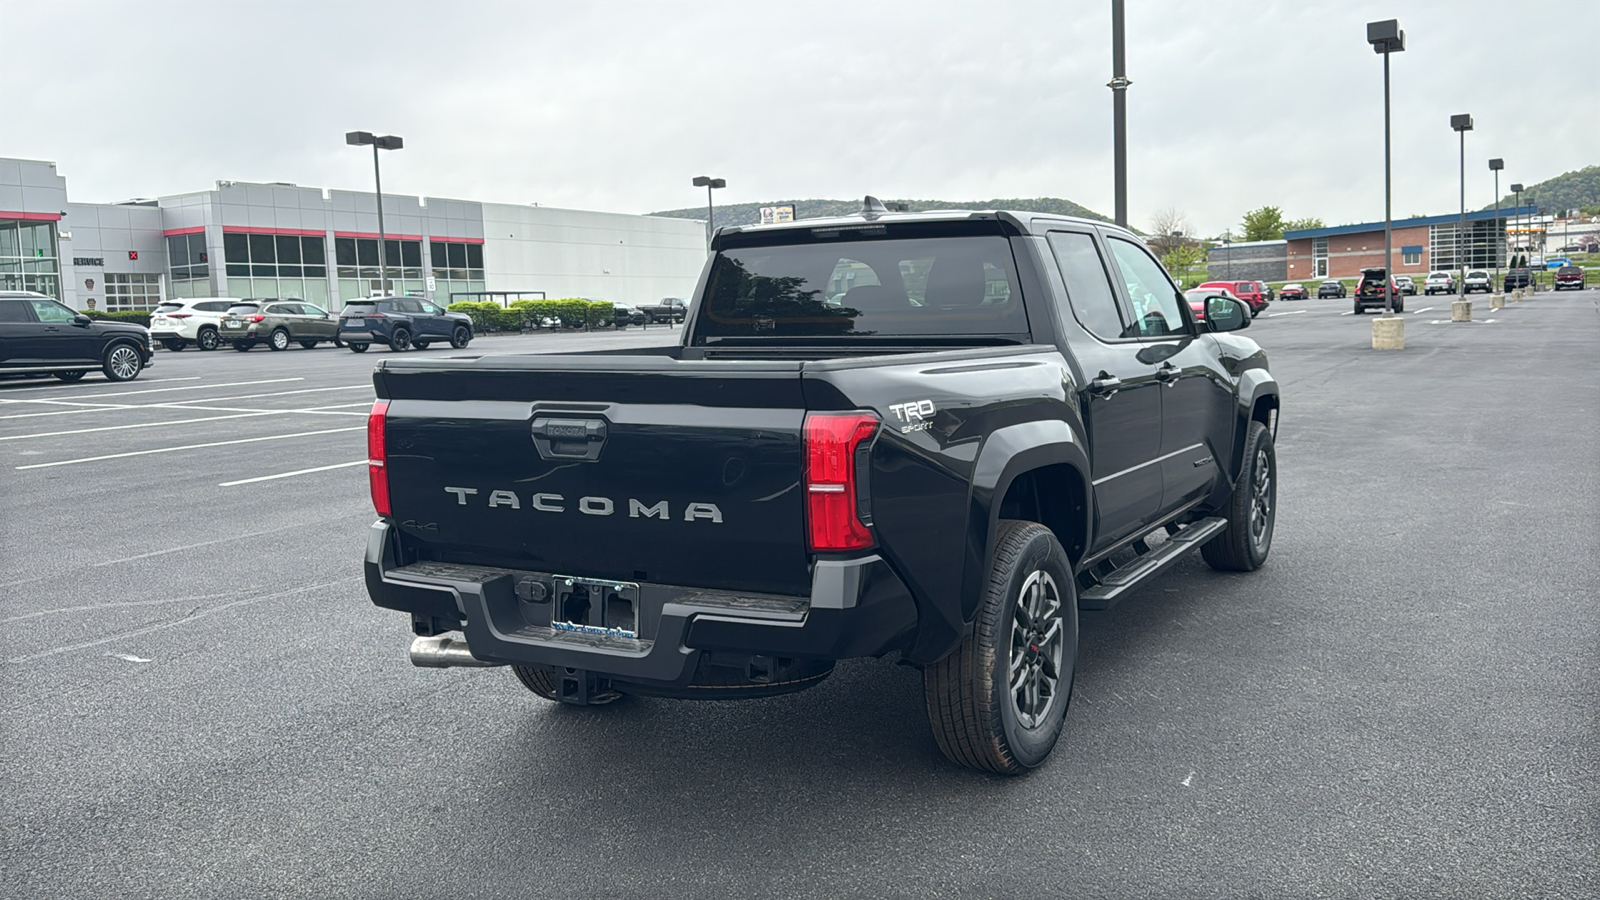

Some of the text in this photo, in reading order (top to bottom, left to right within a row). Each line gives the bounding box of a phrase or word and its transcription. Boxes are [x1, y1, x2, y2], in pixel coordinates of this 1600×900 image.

[889, 399, 936, 422] TRD
[548, 427, 586, 436] TOYOTA
[901, 421, 934, 434] SPORT
[444, 486, 724, 523] TACOMA
